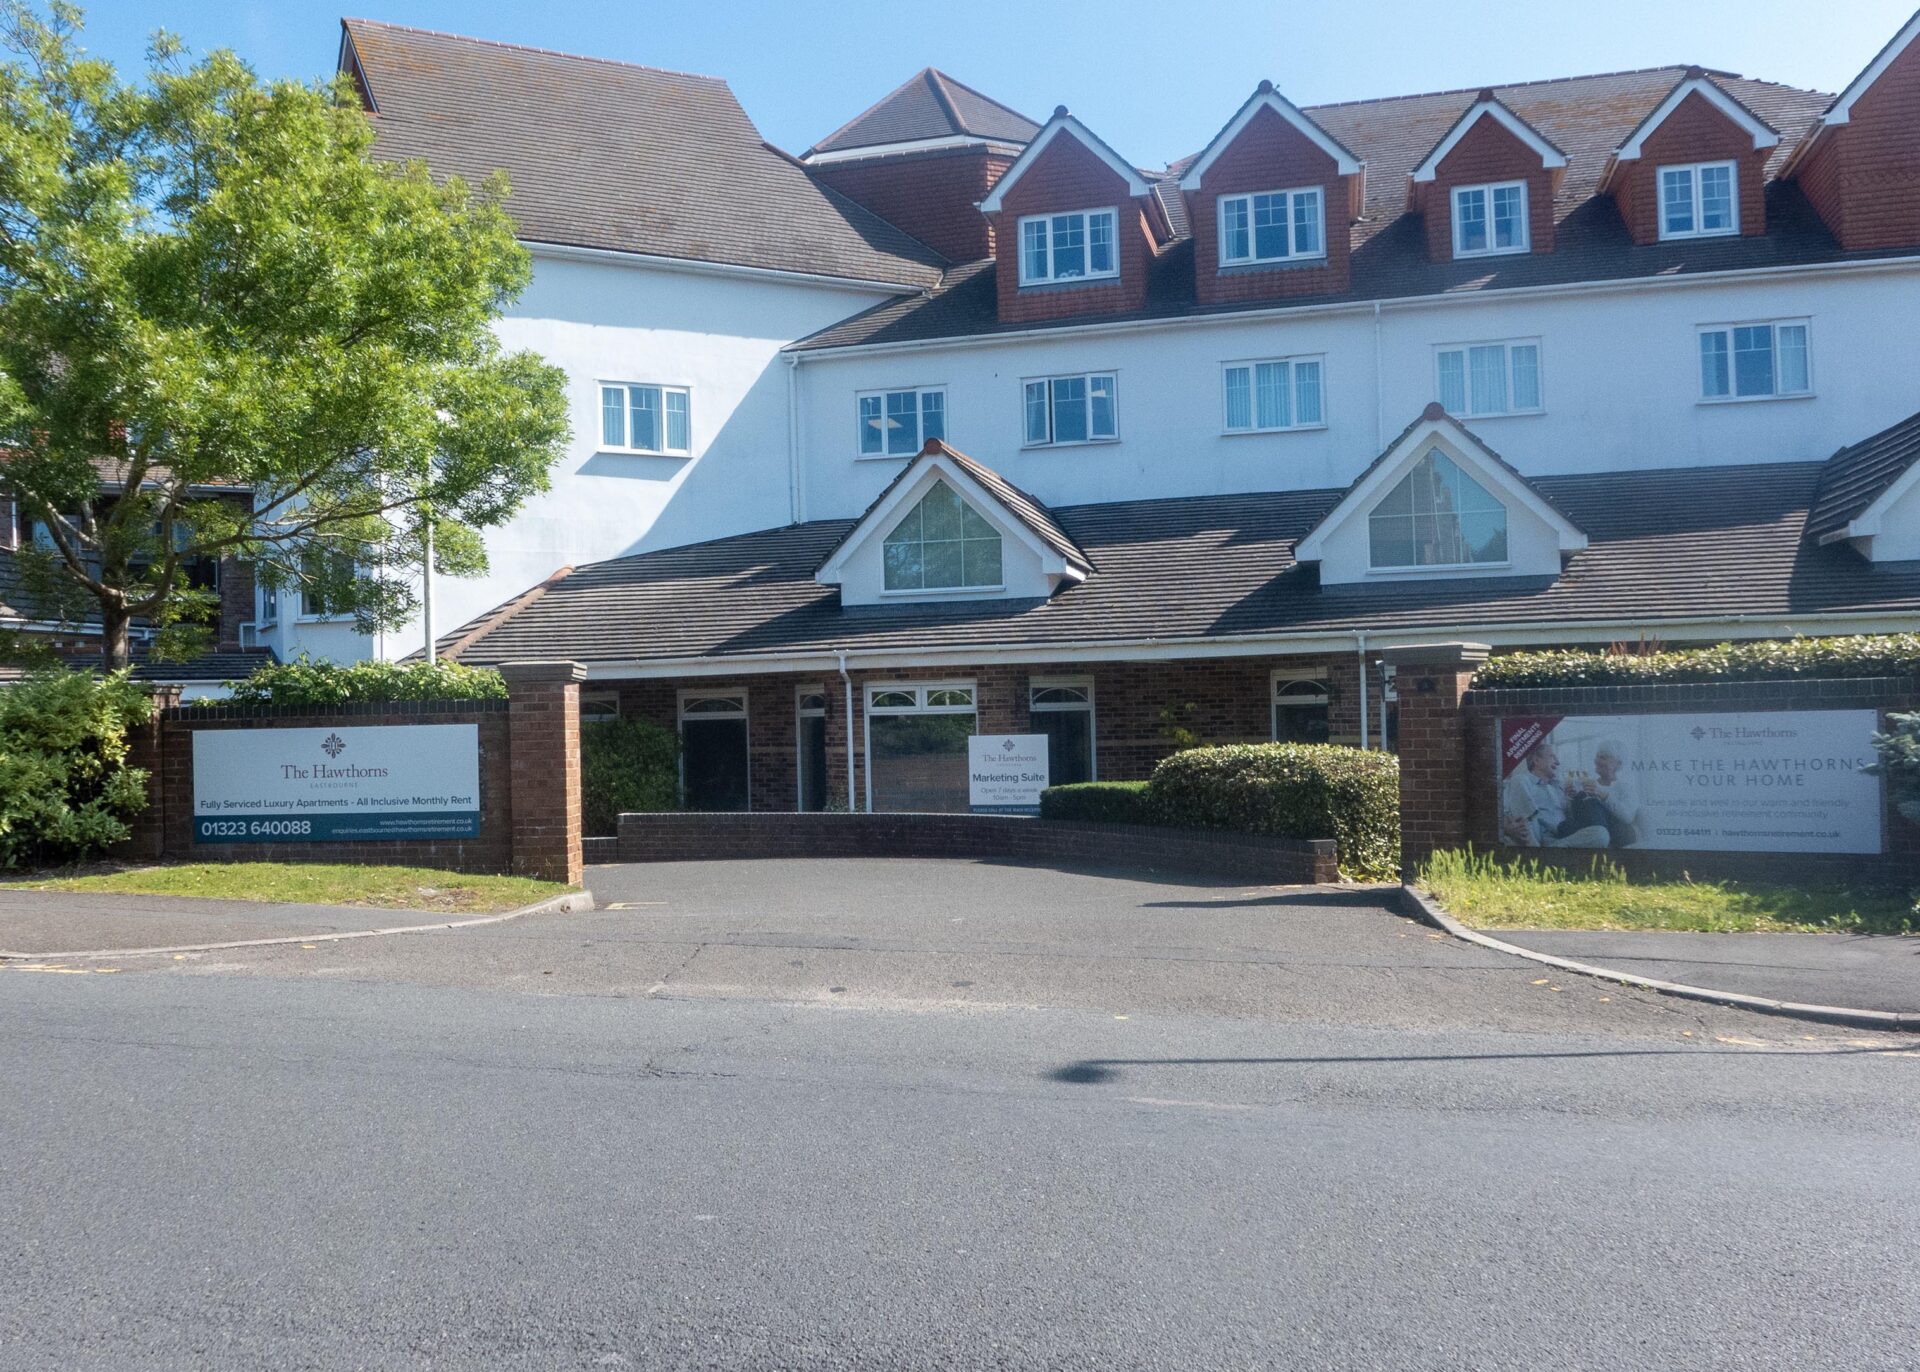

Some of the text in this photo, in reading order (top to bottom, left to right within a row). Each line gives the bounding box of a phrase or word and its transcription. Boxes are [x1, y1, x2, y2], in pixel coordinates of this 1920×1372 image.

[1507, 722, 1540, 757] APARTMENTS
[1509, 727, 1526, 744] FINAL
[1709, 727, 1798, 738] The Hawthorns
[1513, 731, 1542, 759] REMAINING
[982, 753, 1037, 762] The Hawthorns
[1631, 758, 1866, 772] MAKE THE HAWTHORNS
[281, 763, 389, 779] The Hawthorns
[972, 772, 1046, 784] Marketing Suite
[1685, 774, 1805, 787] YOUR HOME
[200, 800, 221, 811] Fully
[223, 800, 261, 809] Serviced
[263, 800, 295, 810] Luxury
[296, 799, 348, 808] Apartments
[357, 797, 368, 806] All
[371, 797, 409, 806] Inclusive
[412, 796, 449, 806] Monthly
[451, 795, 472, 805] Rent
[201, 821, 311, 836] 01323 640088
